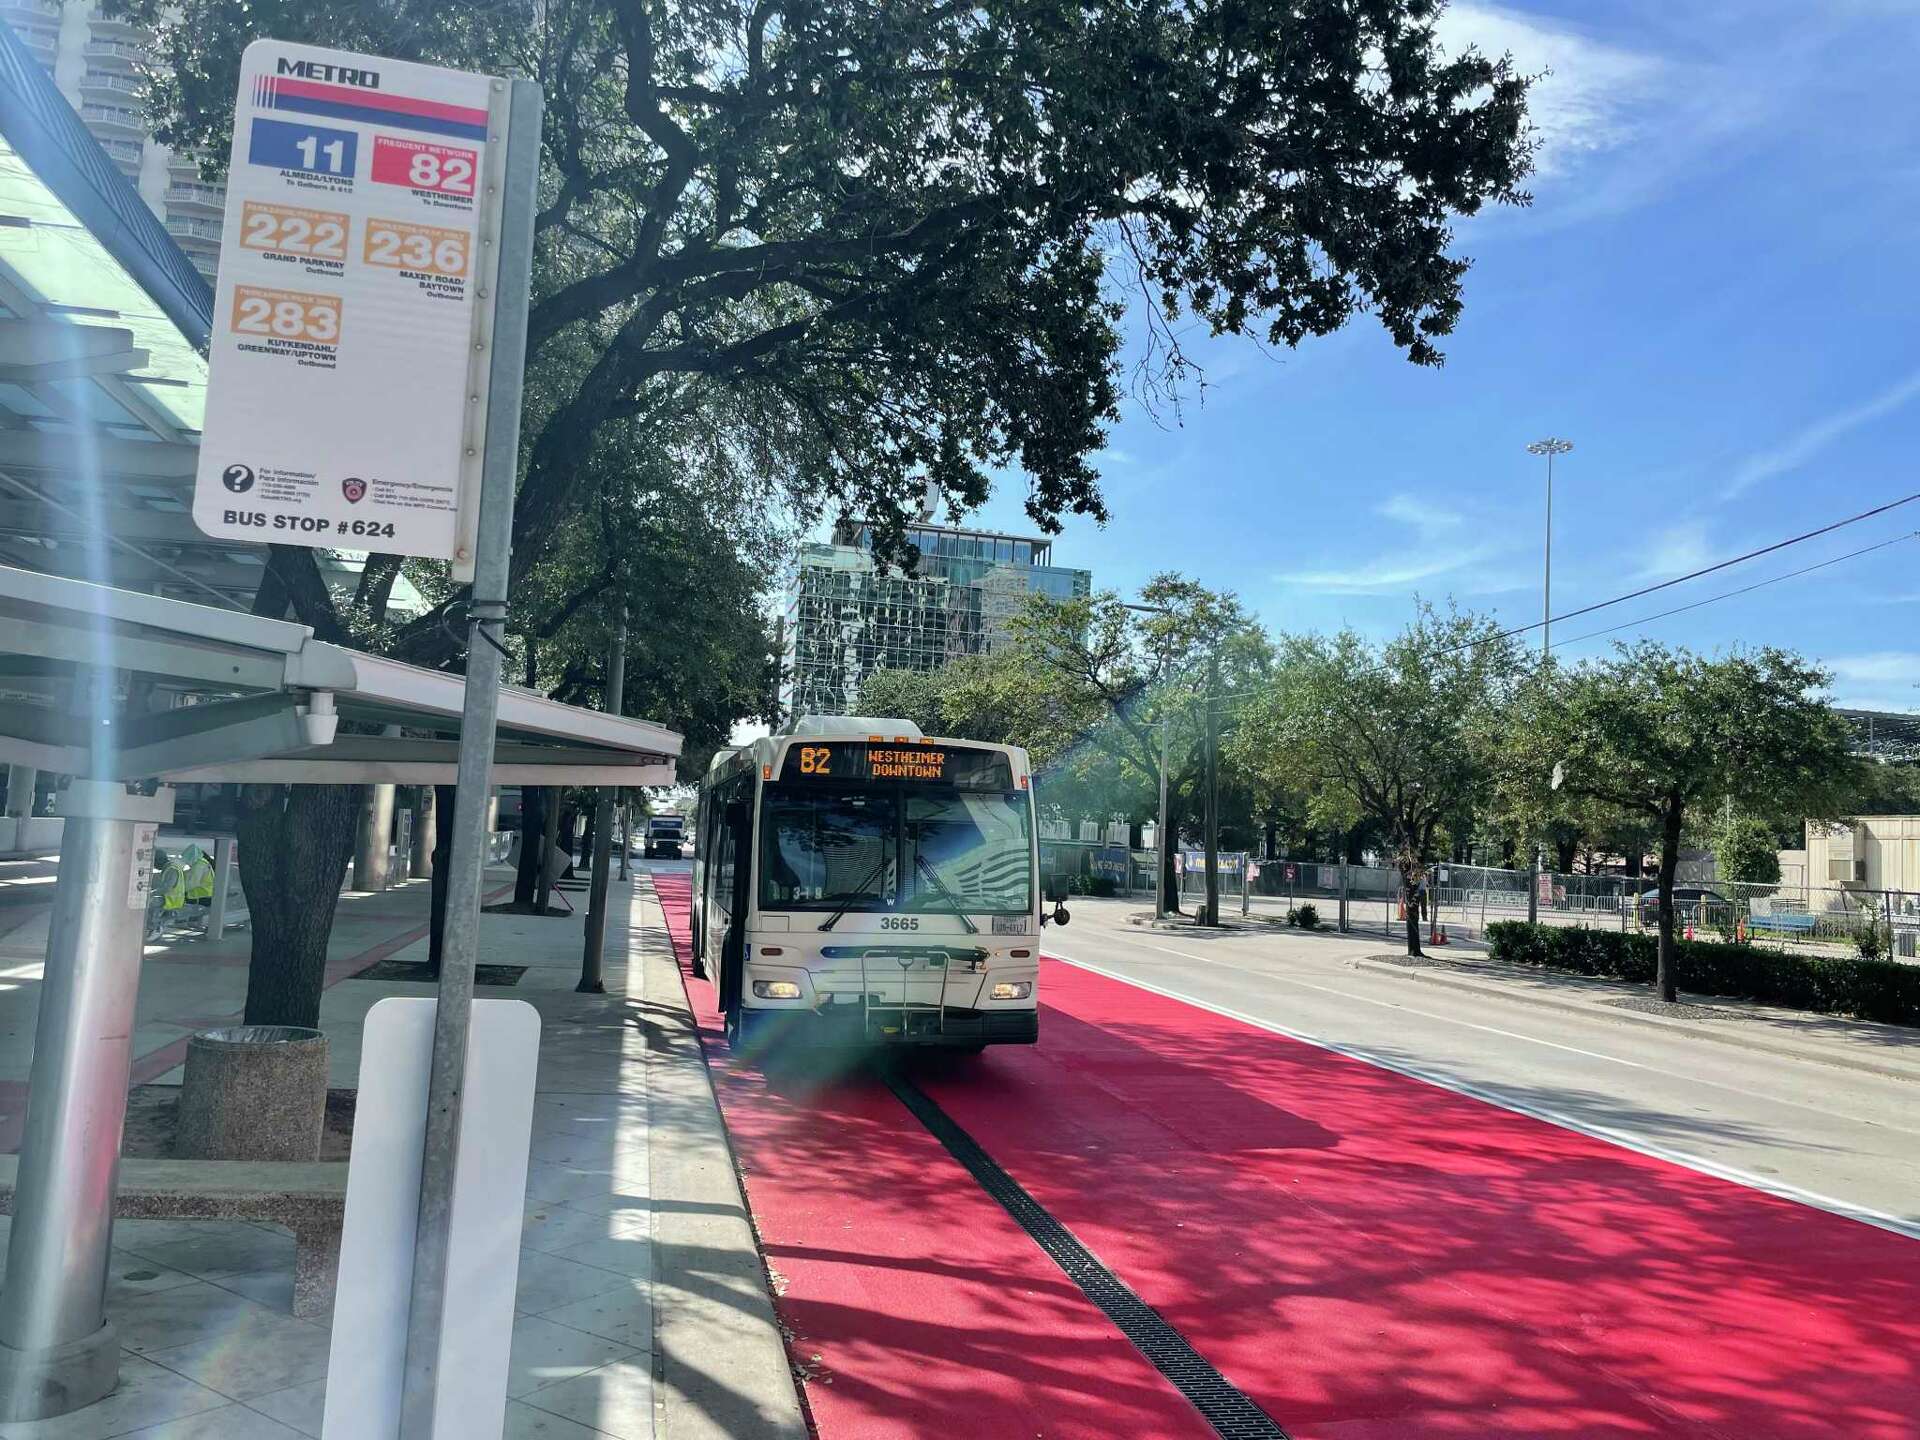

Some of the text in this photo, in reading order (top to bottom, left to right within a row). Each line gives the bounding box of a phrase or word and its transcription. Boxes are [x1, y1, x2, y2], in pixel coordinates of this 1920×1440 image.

[277, 57, 380, 89] METRO
[296, 136, 344, 173] 11
[377, 138, 474, 159] FREQUENT NETWORK
[280, 169, 354, 186] ALMEDA/LYONS
[409, 153, 473, 192] 82
[411, 189, 473, 204] WESTHEIMER
[433, 200, 472, 211] Downtown
[245, 213, 344, 257] 222
[369, 230, 465, 272] 236
[263, 252, 345, 269] GRAND PARKWAY
[306, 267, 344, 277] Outbound
[400, 271, 465, 285] MAXEY ROAD/
[419, 281, 464, 294] BAYTOWN
[427, 291, 463, 301] Outbound
[238, 297, 338, 339] 283
[237, 343, 336, 361] GREENWAY/UPTOWN
[267, 339, 338, 353] KUYKENDAHL/
[298, 360, 336, 369] Outbound
[223, 510, 395, 538] BUS STOP #624
[800, 747, 831, 774] 82
[868, 750, 945, 765] WESTHEIMER
[872, 763, 942, 777] DOWNTOWN
[880, 917, 919, 931] 3665
